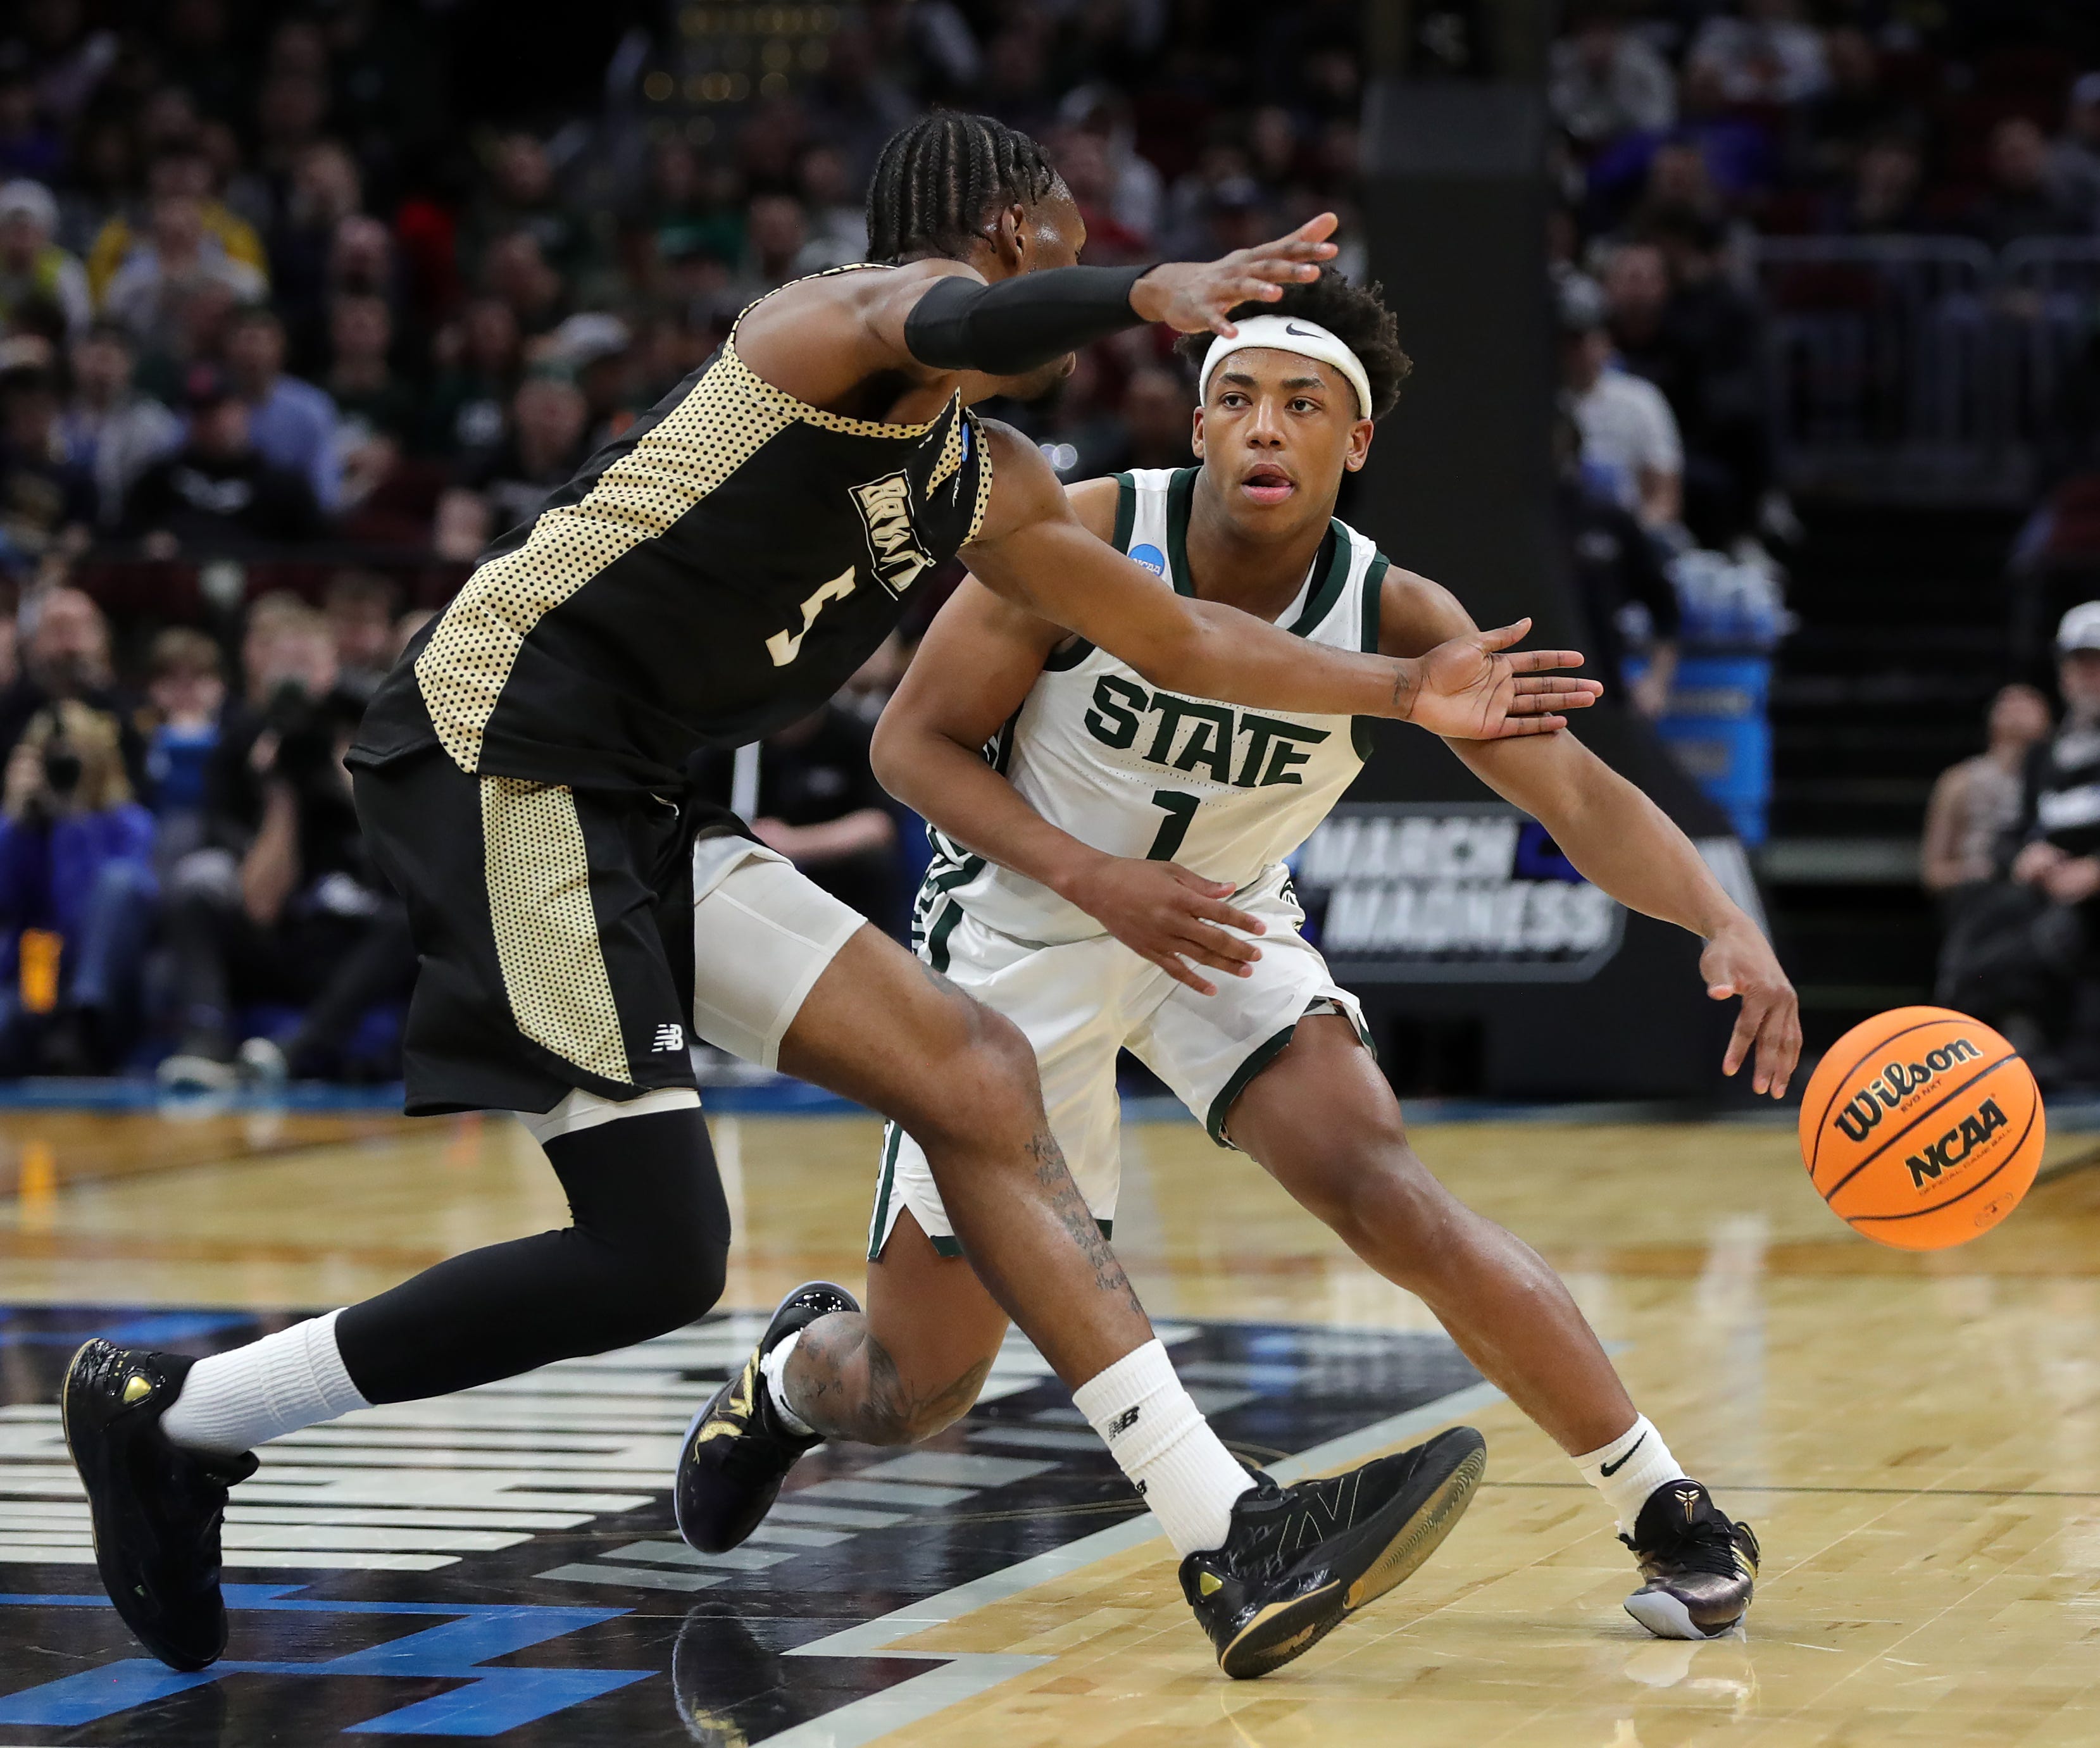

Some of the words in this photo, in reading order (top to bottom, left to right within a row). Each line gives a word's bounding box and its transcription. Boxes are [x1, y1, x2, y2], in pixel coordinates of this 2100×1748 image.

[765, 565, 856, 667] 5
[1084, 675, 1332, 789] STATE
[1146, 790, 1201, 861] 1
[1834, 1038, 1984, 1144] Wilson
[1904, 1096, 2008, 1191] NCAA
